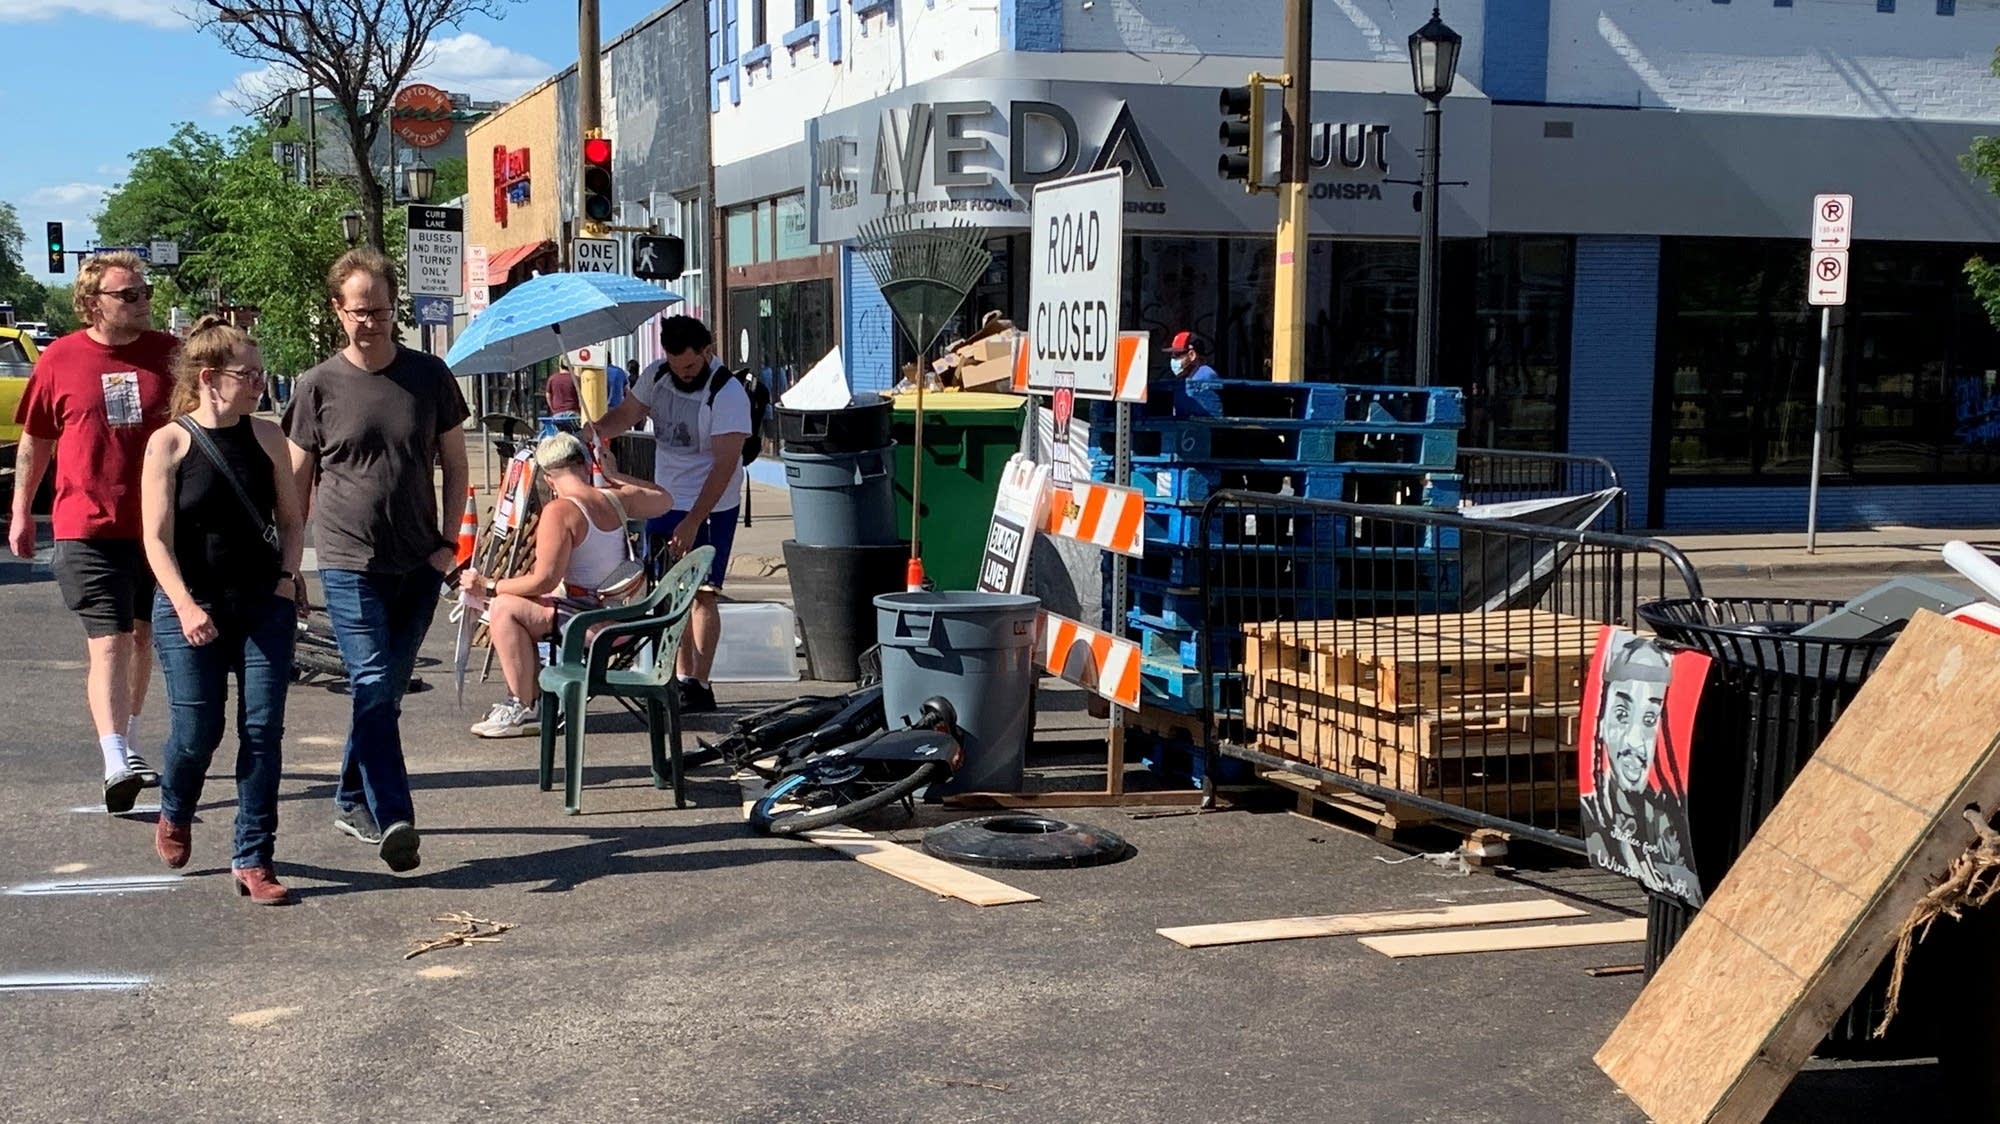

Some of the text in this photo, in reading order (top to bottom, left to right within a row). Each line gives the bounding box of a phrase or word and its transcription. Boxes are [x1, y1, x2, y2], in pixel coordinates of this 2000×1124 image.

[401, 87, 445, 104] UPTOWN
[402, 127, 446, 143] UPTOWN
[872, 100, 1166, 194] AVEDA
[1308, 123, 1390, 172] UUT
[940, 199, 967, 212] PURE
[425, 210, 446, 218] CURB
[425, 220, 446, 228] LANE
[418, 232, 453, 243] BUSES
[1047, 210, 1100, 274] ROAD
[412, 244, 459, 255] AND RIGHT
[579, 243, 613, 259] ONE
[419, 255, 452, 266] TURNS
[578, 261, 614, 273] WAY
[421, 267, 449, 276] ONLY
[1036, 300, 1108, 361] CLOSED
[989, 525, 1018, 561] BLACK
[984, 558, 1009, 592] LIVES
